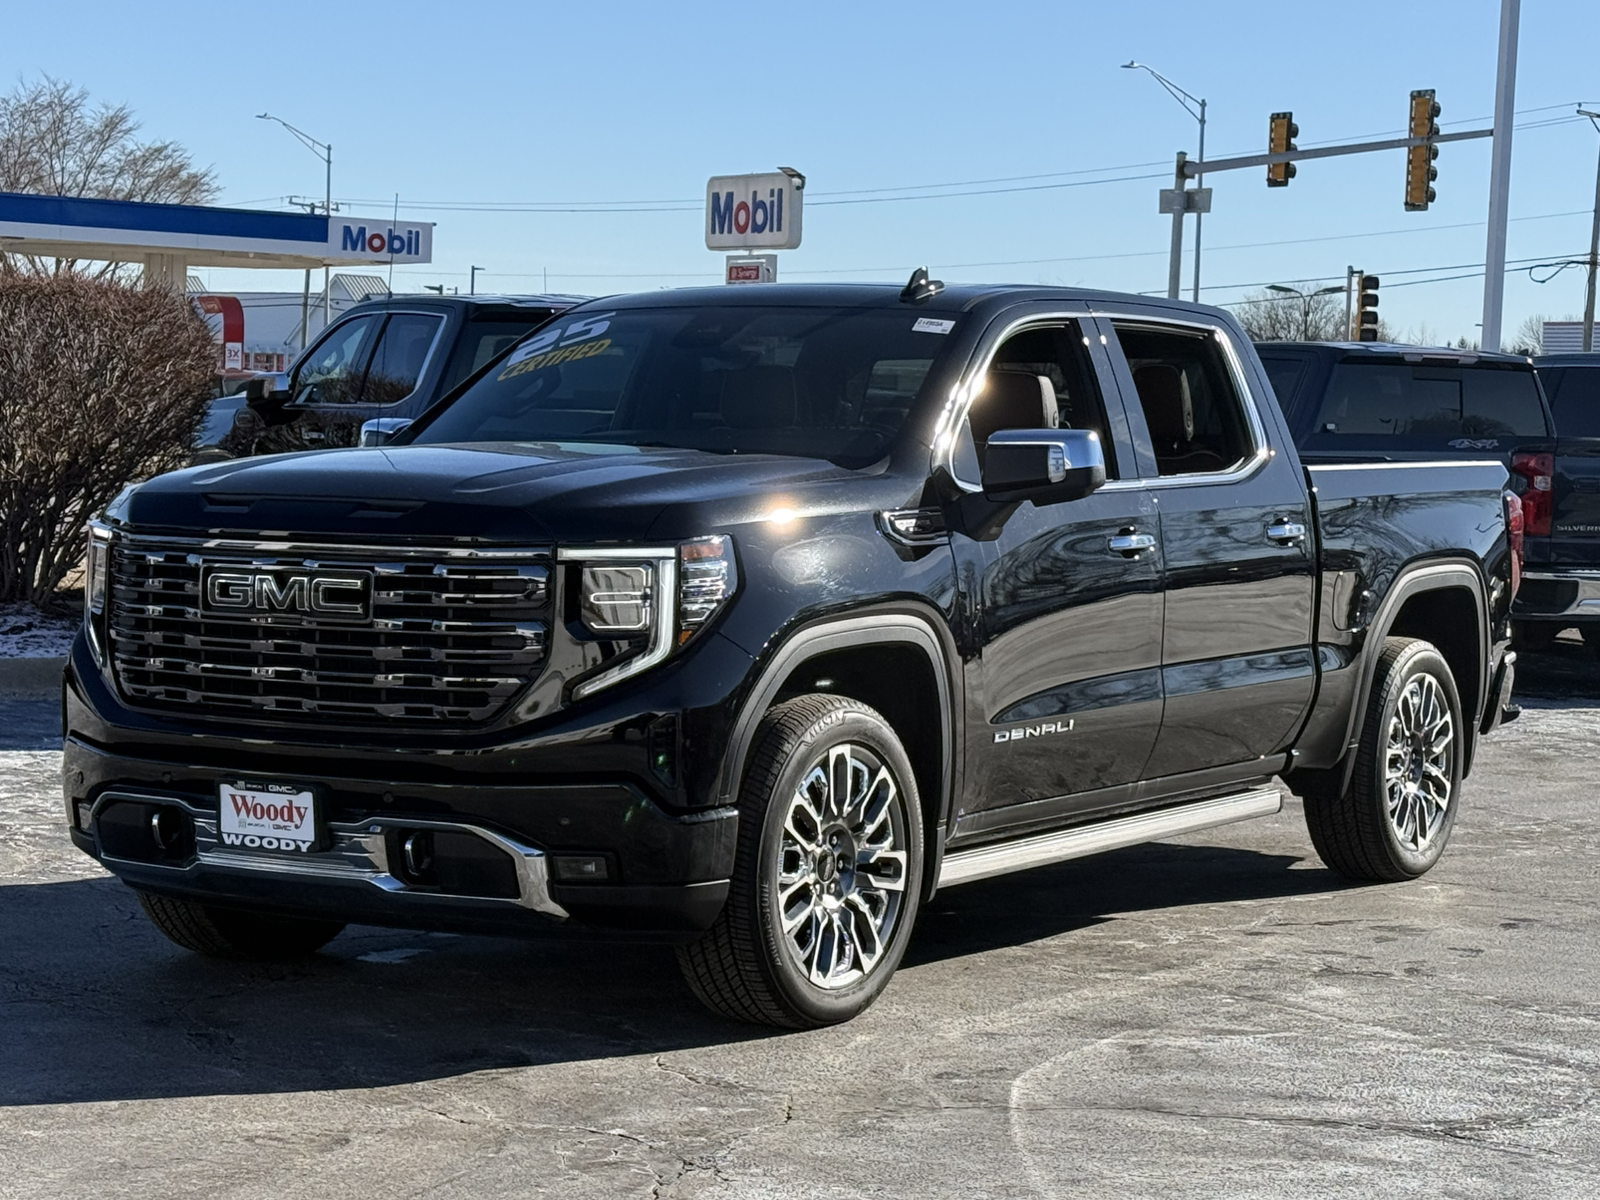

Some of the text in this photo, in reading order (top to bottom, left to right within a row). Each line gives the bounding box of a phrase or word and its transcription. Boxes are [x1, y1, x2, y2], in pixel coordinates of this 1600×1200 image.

[710, 188, 784, 235] Mobil
[342, 225, 420, 256] Mobil
[226, 348, 240, 359] 3X
[506, 311, 617, 367] 25
[497, 338, 612, 382] CERTIFIED
[207, 572, 365, 615] GMC
[992, 718, 1075, 744] DENALI
[268, 784, 293, 794] GMC
[229, 793, 309, 830] Woody
[221, 832, 313, 853] WOODY
[272, 823, 292, 832] GMC
